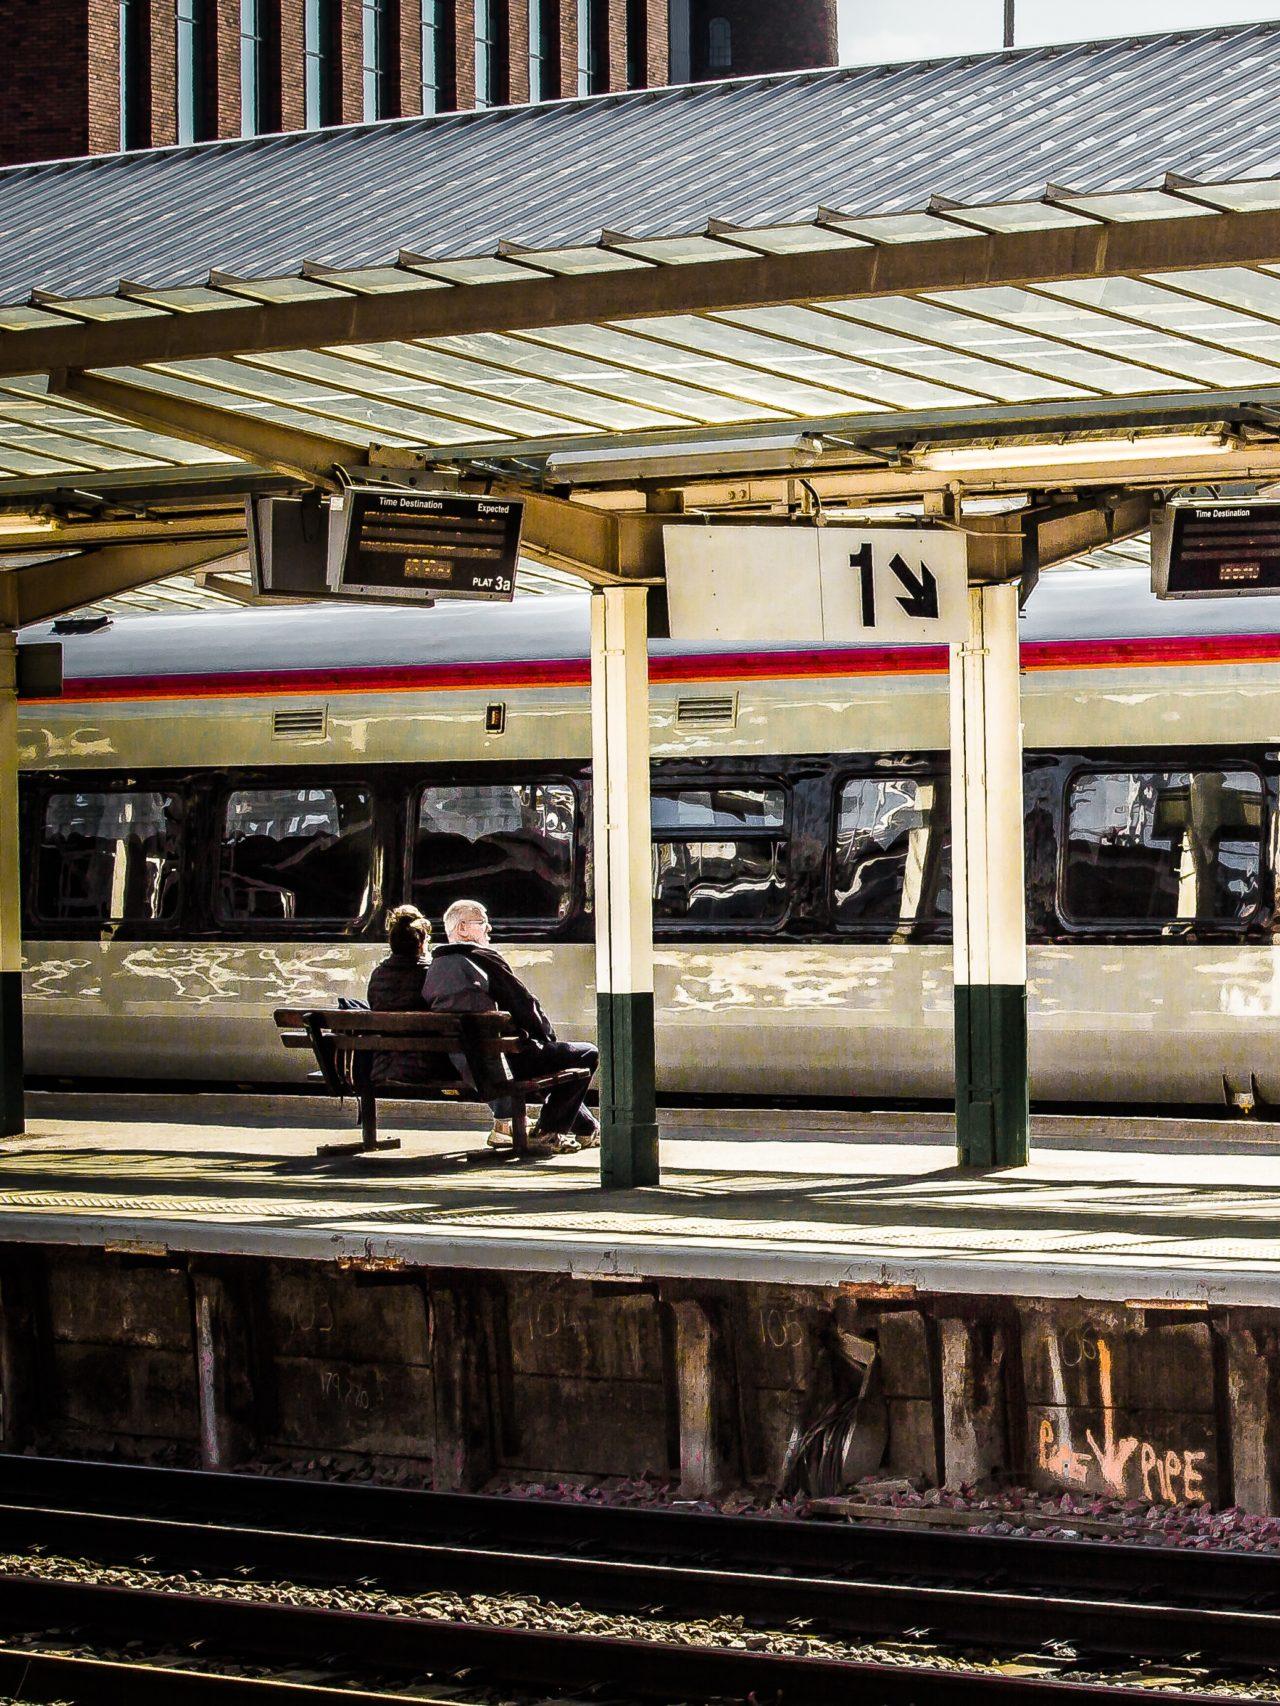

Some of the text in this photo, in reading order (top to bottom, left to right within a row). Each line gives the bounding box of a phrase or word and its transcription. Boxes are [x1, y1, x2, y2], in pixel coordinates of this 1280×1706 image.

[379, 497, 510, 514] Time Destination Expected
[1196, 510, 1212, 518] Time
[1213, 508, 1251, 518] Destination
[472, 575, 511, 591] PLAT 3a
[849, 542, 876, 628] 1
[760, 1309, 803, 1347] 105
[1141, 1442, 1206, 1504] PIPE
